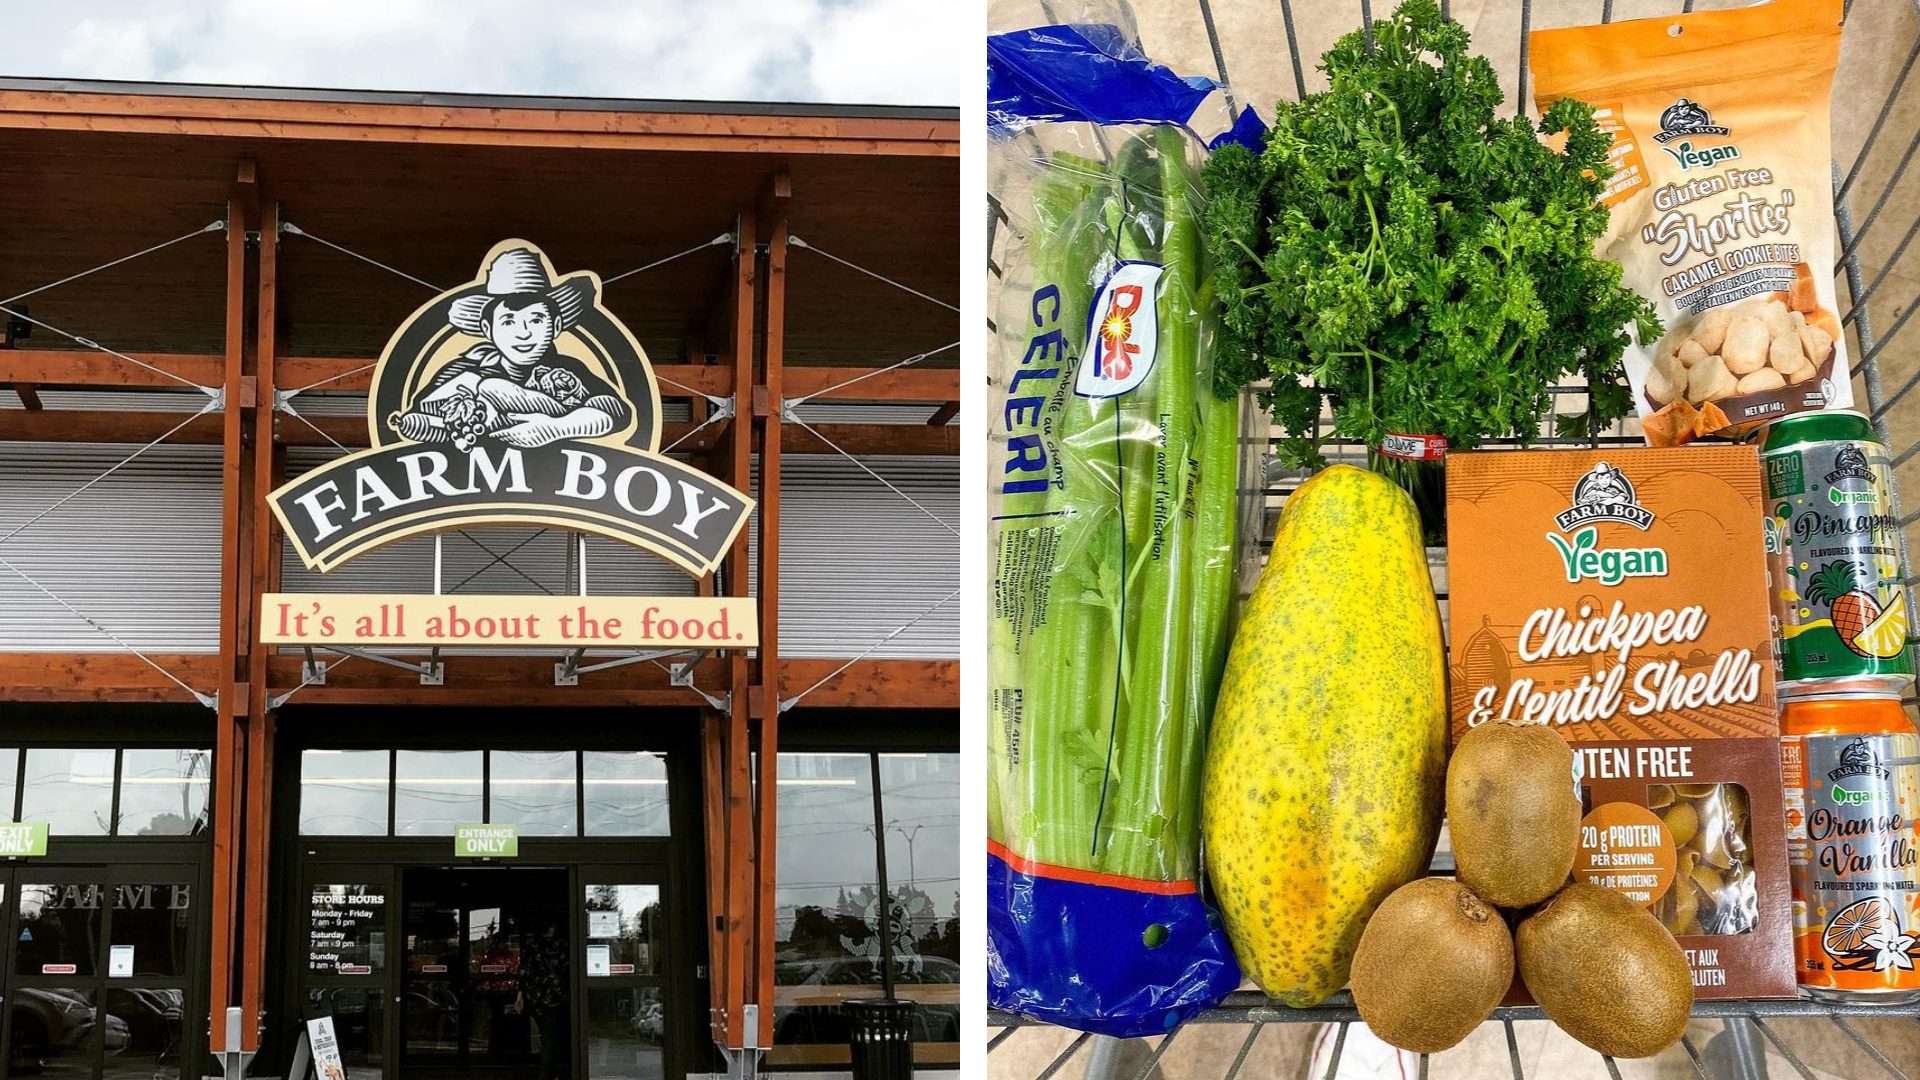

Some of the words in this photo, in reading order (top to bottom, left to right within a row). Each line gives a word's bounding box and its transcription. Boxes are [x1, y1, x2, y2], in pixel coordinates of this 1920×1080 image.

[1656, 128, 1691, 141] FARM
[1696, 127, 1726, 135] BOY
[1663, 142, 1738, 169] Vegan
[1654, 176, 1727, 211] Gluten
[1725, 168, 1773, 189] Free
[1662, 258, 1725, 296] CARAMEL
[1725, 244, 1774, 271] COOKIE
[1774, 244, 1800, 263] BITES
[1715, 281, 1727, 292] DE
[1727, 269, 1763, 288] BISCUITS
[1751, 281, 1772, 295] SANS
[1101, 285, 1143, 381] Dole
[1003, 284, 1069, 494] CÉLERI
[1744, 407, 1758, 417] NET
[1758, 404, 1769, 414] WT
[1044, 417, 1053, 436] au
[1159, 413, 1171, 448] Laver
[1047, 441, 1064, 490] champ
[1157, 452, 1169, 486] avant
[1769, 454, 1799, 476] ZERO
[1826, 467, 1855, 482] FARM
[1858, 468, 1876, 481] BOY
[294, 447, 532, 543] FARM
[556, 449, 732, 541] BOY
[1186, 479, 1195, 497] aux
[1152, 491, 1171, 561] l'utilisation
[1561, 504, 1610, 528] FARM
[1613, 504, 1651, 528] BOY
[1548, 528, 1666, 582] Vegan
[1810, 547, 1849, 558] FLAVOURED
[1850, 547, 1882, 555] SARKLING
[275, 602, 336, 638] It's
[355, 603, 406, 638] all
[425, 605, 542, 640] about
[559, 607, 622, 640] the
[640, 608, 744, 641] food.
[1518, 600, 1709, 662] Chickpea
[1468, 686, 1498, 728] &
[1501, 663, 1628, 727] Lentil
[1628, 648, 1763, 717] Shells
[1636, 747, 1694, 778] FREE
[1781, 746, 1802, 764] ERO
[1831, 765, 1865, 780] FARM
[1831, 784, 1890, 805] Orgaic
[0, 826, 33, 839] EXIT
[459, 828, 515, 839] ENTRANCE
[1807, 808, 1903, 846] Orange
[467, 838, 507, 852] ONLY
[1582, 826, 1597, 848] 20
[1600, 830, 1608, 853] g
[1609, 825, 1661, 848] PROTEIN
[1591, 854, 1610, 866] PER
[1612, 853, 1654, 866] SERVING
[1820, 838, 1916, 876] Vanilla
[1607, 876, 1616, 888] DE
[1618, 871, 1658, 888] PROTÉINES
[1814, 881, 1855, 890] FLAVOURED
[1856, 880, 1895, 891] SPARKING
[1896, 881, 1914, 890] WATER
[311, 895, 346, 904] STORE
[348, 895, 385, 904] HOURS
[311, 910, 343, 918] Monday
[349, 910, 374, 919] Friday
[336, 918, 341, 926] 9
[310, 931, 346, 940] Saturday
[342, 941, 355, 949] pm
[310, 952, 339, 961] Sunday
[1684, 949, 1697, 966] ET
[1699, 949, 1719, 966] AUX
